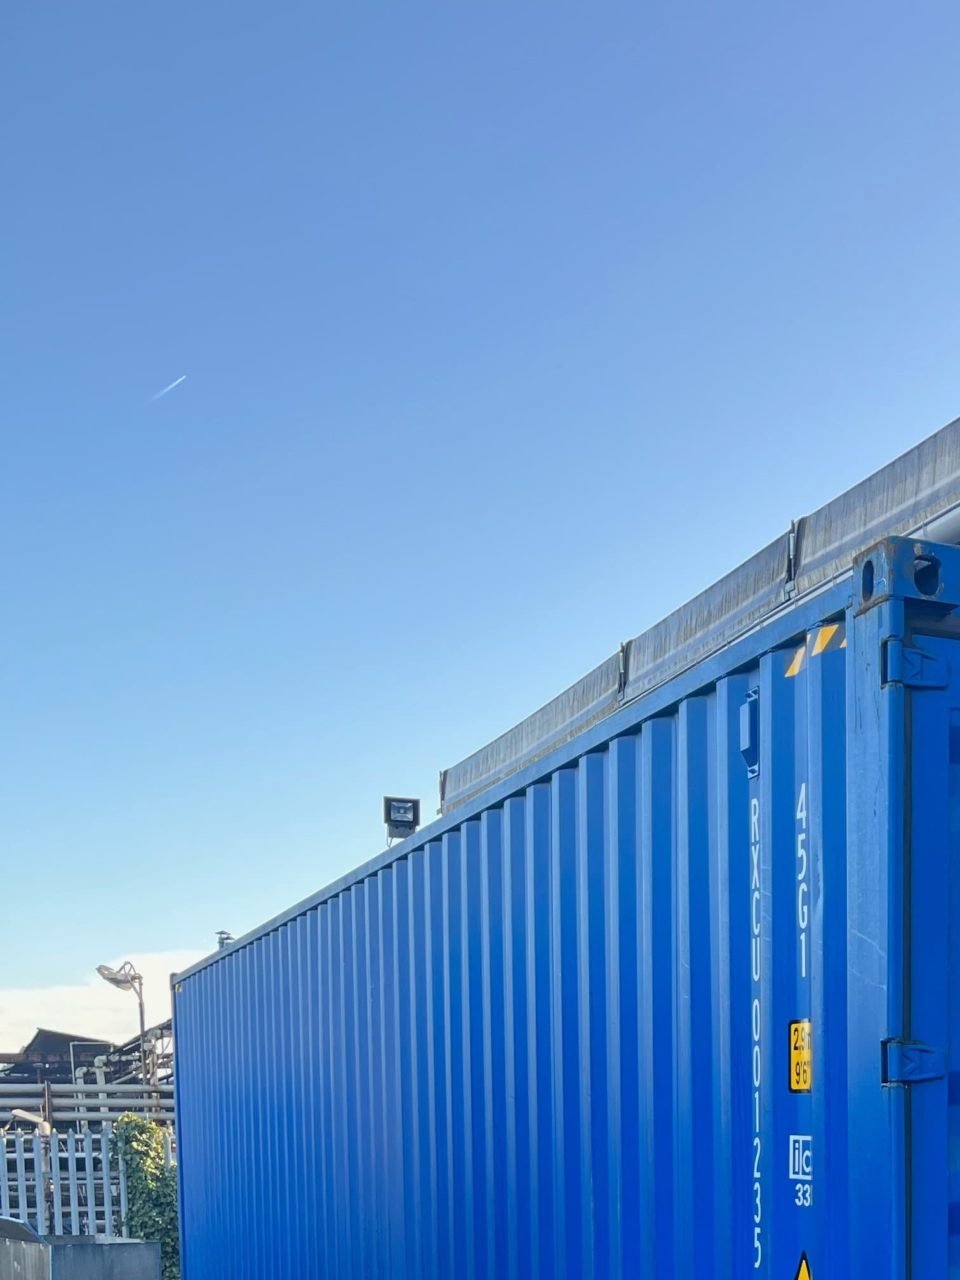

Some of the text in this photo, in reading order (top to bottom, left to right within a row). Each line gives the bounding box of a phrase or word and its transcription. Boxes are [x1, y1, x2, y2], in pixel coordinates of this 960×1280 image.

[750, 797, 761, 982] RXCU
[796, 782, 808, 978] 45G1
[751, 998, 762, 1269] 001235
